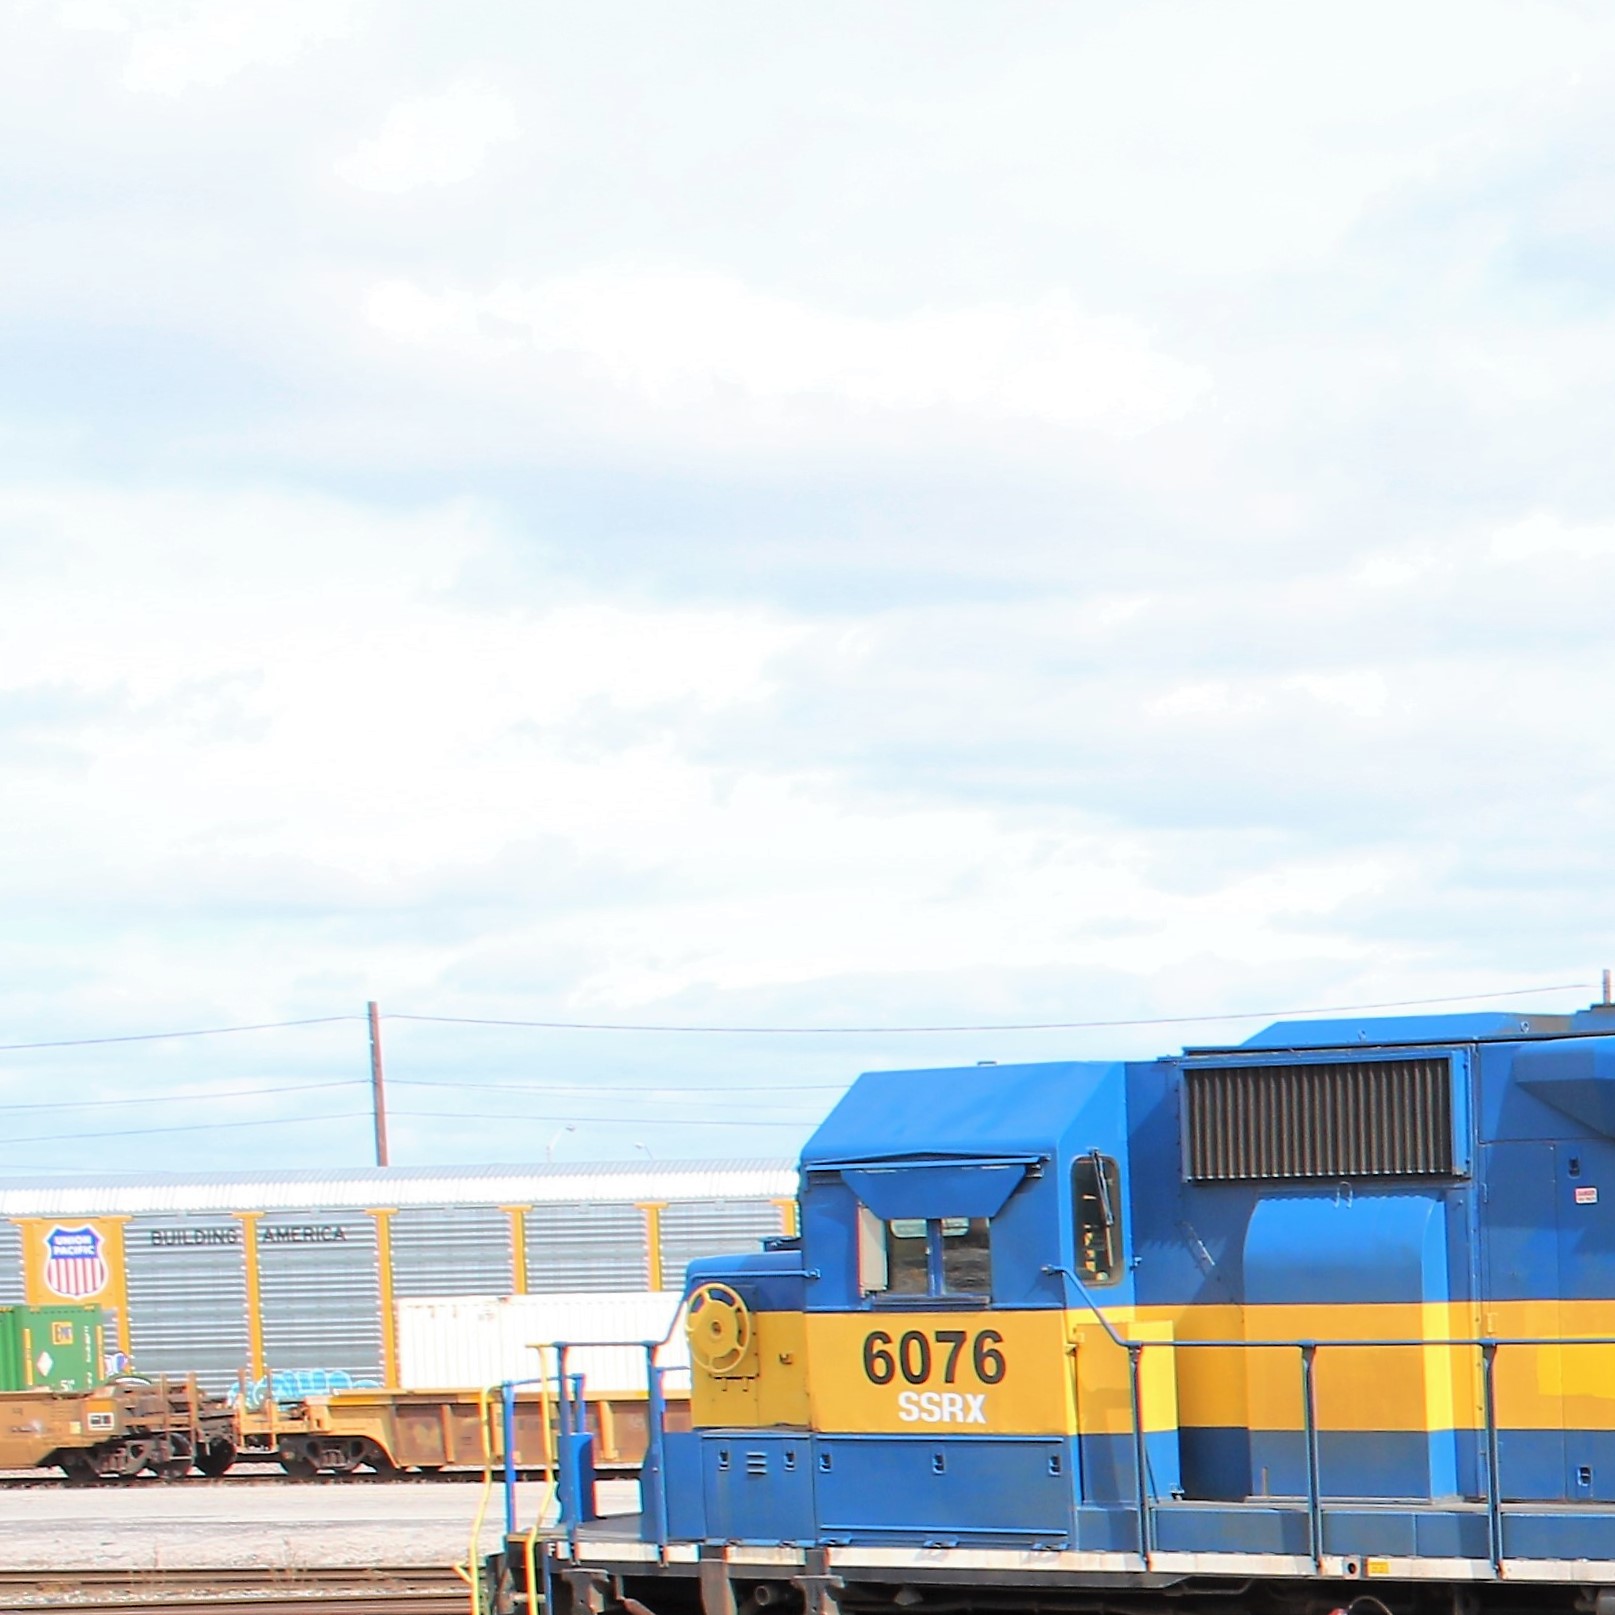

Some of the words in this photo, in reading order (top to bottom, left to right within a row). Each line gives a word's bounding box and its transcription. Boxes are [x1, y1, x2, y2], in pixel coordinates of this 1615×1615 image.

[54, 1235, 92, 1245] UNION
[150, 1229, 237, 1245] BUILDING
[263, 1227, 346, 1242] AMERICA
[53, 1245, 95, 1255] PACIFIC
[863, 1329, 1006, 1385] 6076
[897, 1391, 987, 1424] SSRX
